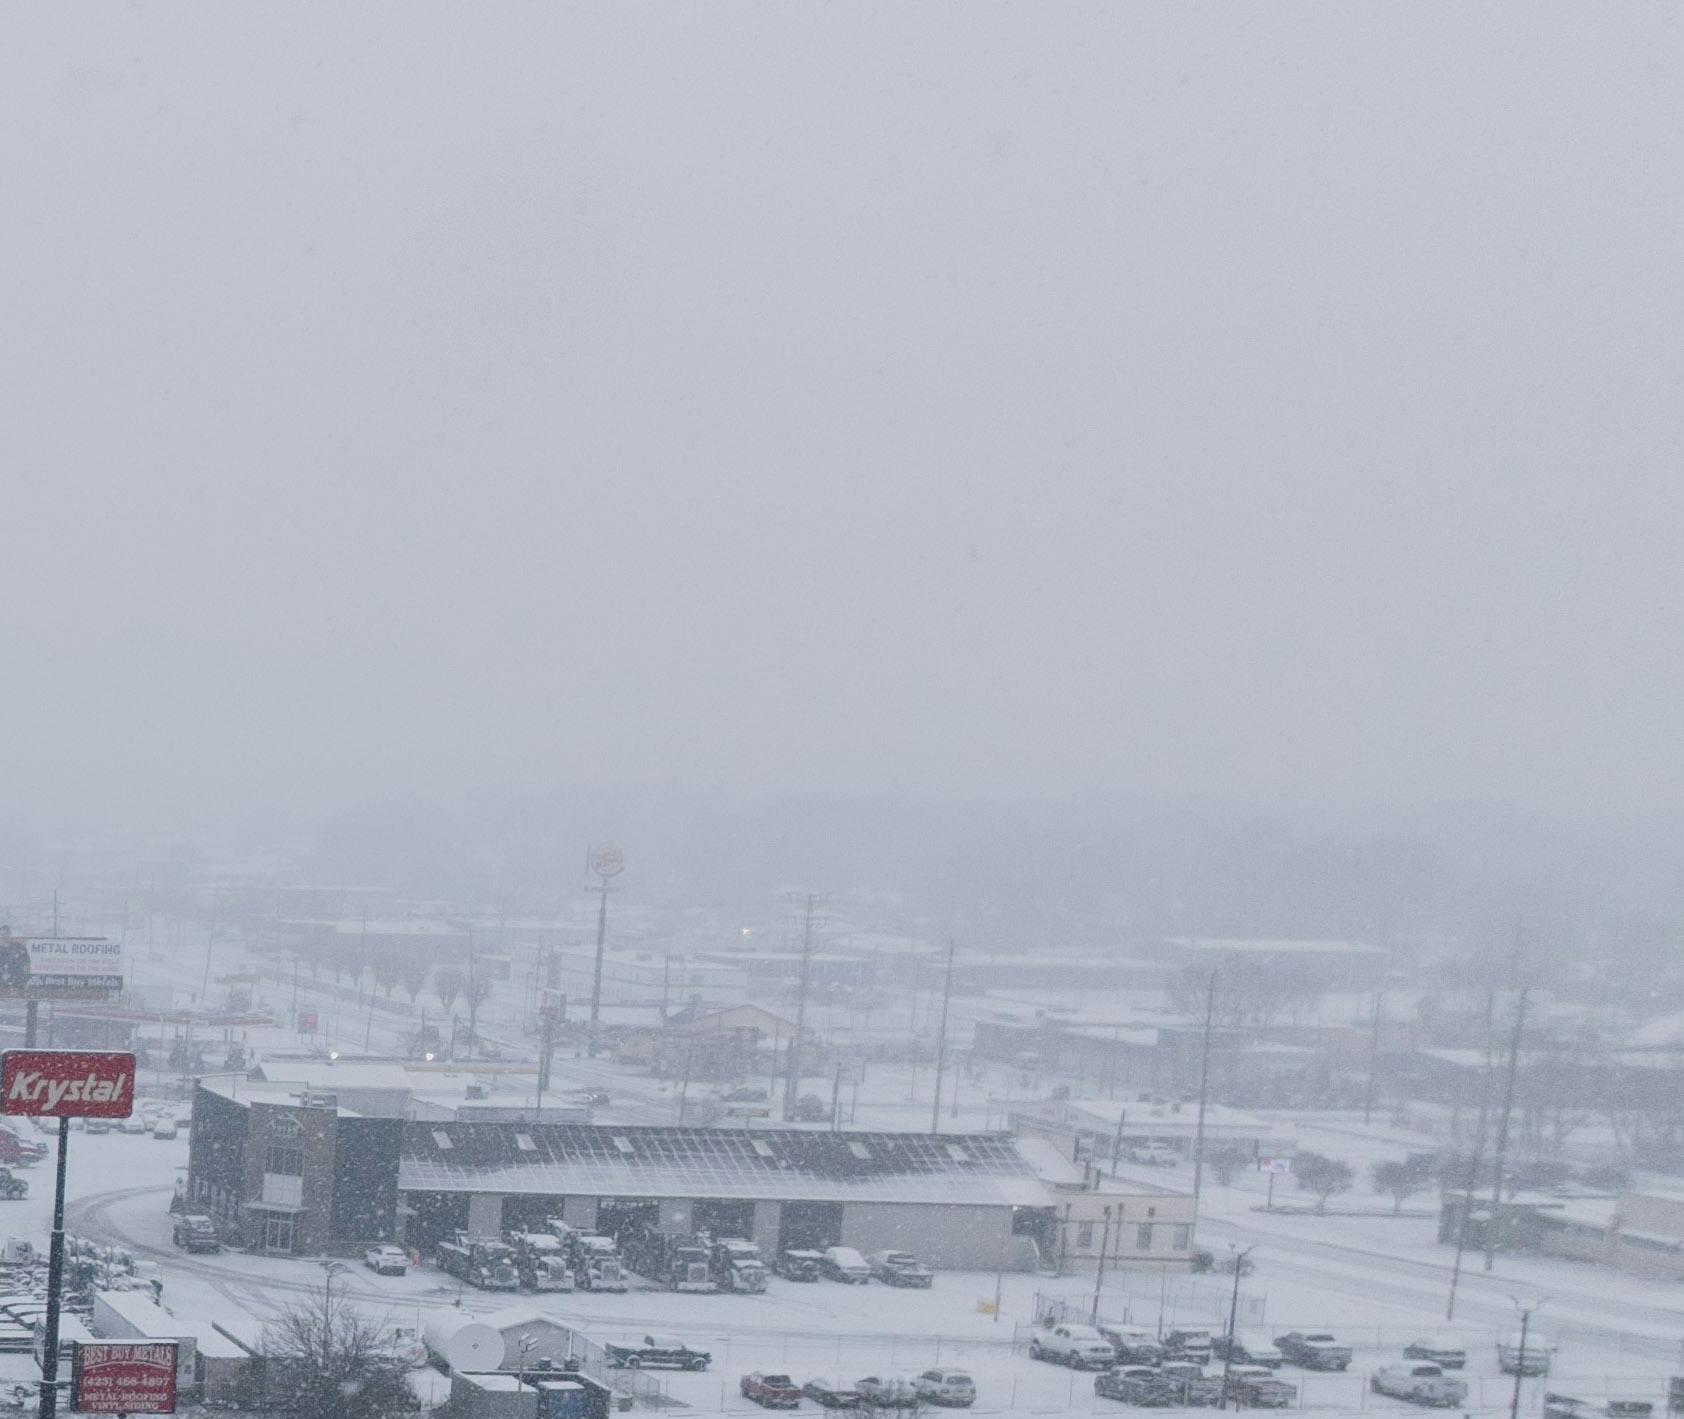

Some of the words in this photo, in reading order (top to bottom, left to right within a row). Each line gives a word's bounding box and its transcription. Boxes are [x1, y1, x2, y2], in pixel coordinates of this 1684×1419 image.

[31, 943, 68, 954] METAL
[72, 943, 120, 955] ROOFING
[8, 1071, 127, 1111] Krystal
[83, 1345, 108, 1366] BEST
[112, 1346, 132, 1360] BUY
[134, 1346, 172, 1366] METALS
[84, 1376, 113, 1388] (423)
